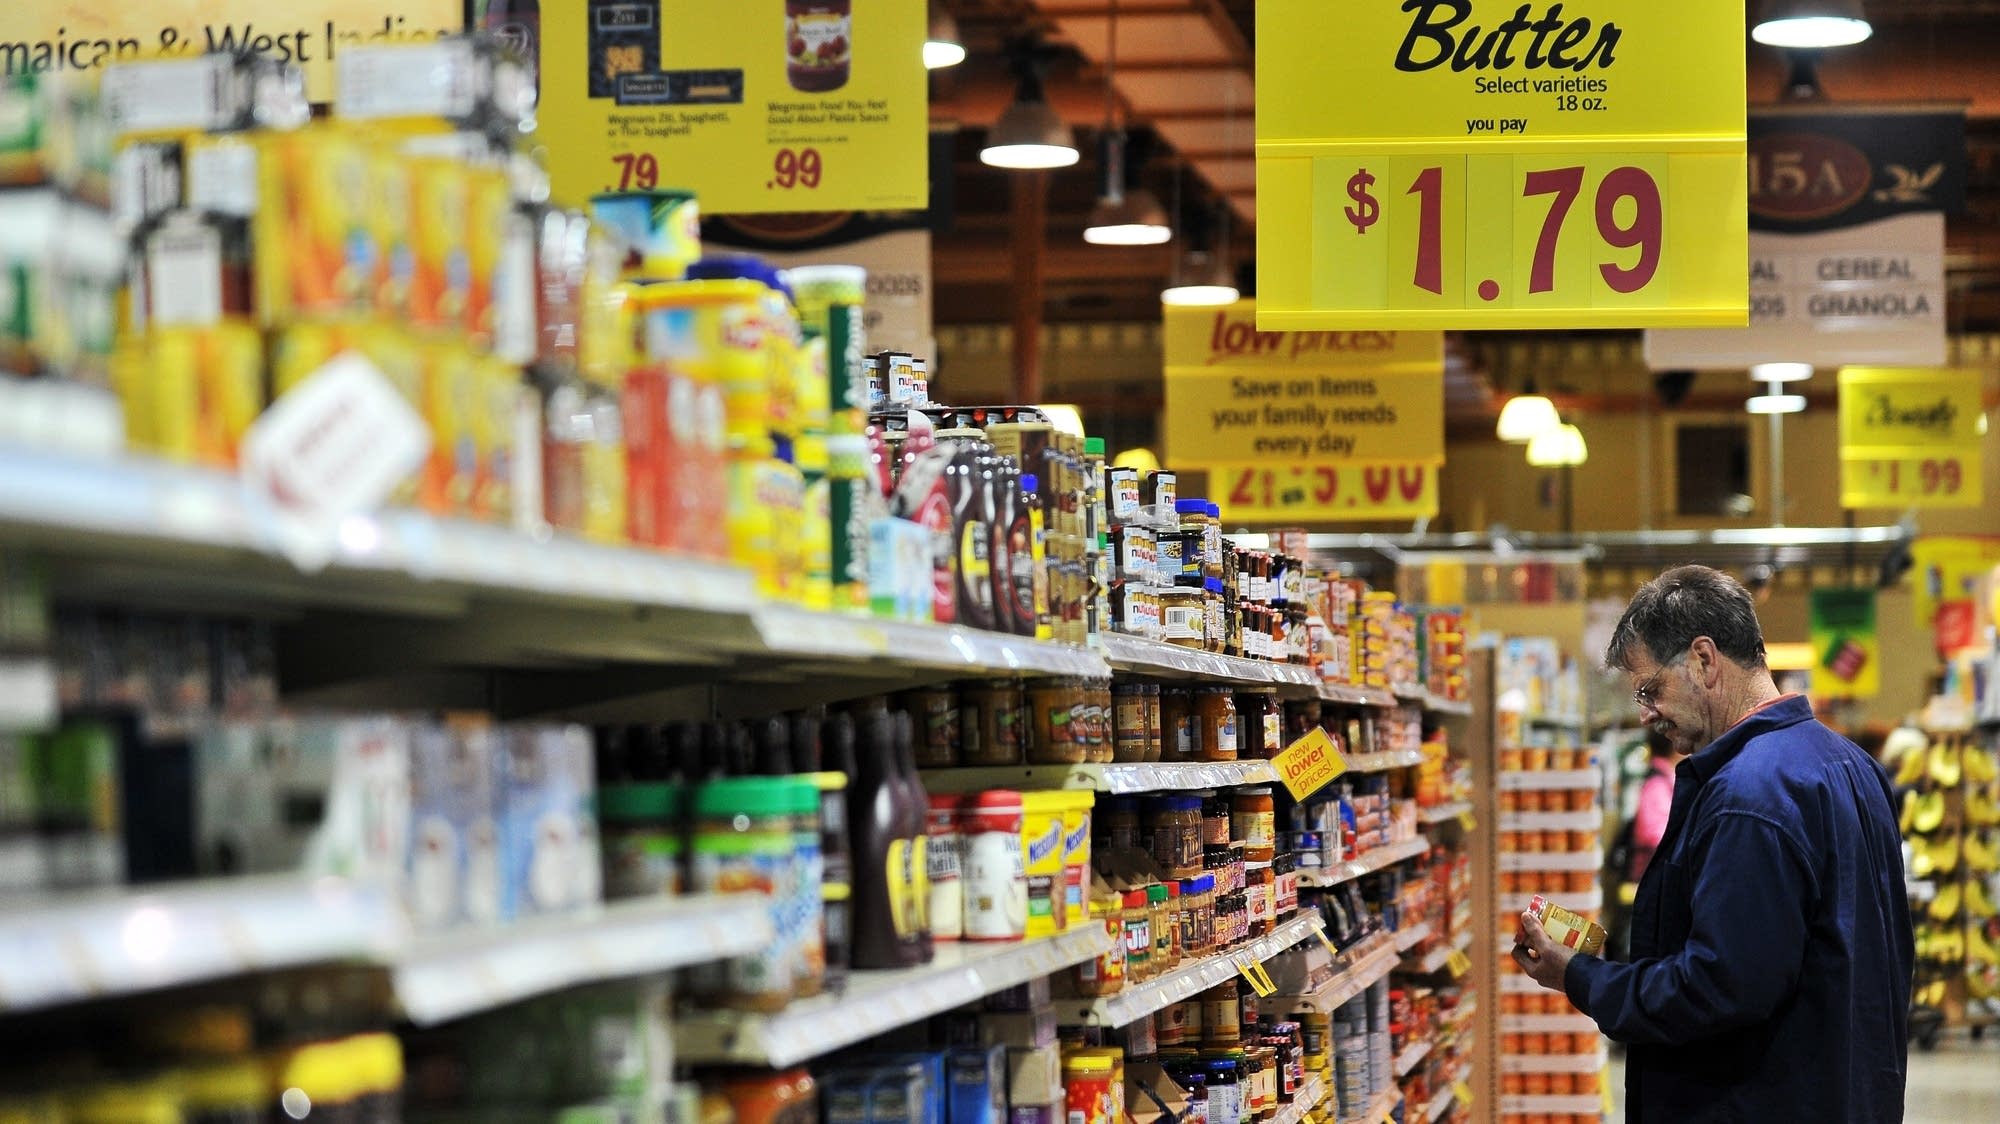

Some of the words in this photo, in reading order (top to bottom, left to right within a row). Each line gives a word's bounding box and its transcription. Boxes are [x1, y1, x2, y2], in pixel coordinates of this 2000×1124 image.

[1394, 0, 1622, 73] Butter
[1475, 76, 1529, 94] Select
[1532, 75, 1608, 94] varieties
[1556, 95, 1578, 112] 18
[1582, 98, 1608, 112] oz.
[1466, 118, 1494, 134] you
[1500, 117, 1527, 134] pay
[1816, 258, 1914, 281] CEREAL
[1807, 294, 1931, 317] GRANOLA
[1232, 376, 1281, 398] Save
[1288, 381, 1310, 397] on
[1212, 407, 1257, 430] your
[1264, 403, 1328, 428] family
[1334, 402, 1397, 424] needs
[1253, 437, 1312, 457] every
[1317, 432, 1357, 456] day
[1284, 744, 1325, 779] lower
[1288, 742, 1310, 764] new
[1298, 759, 1334, 794] prices!
